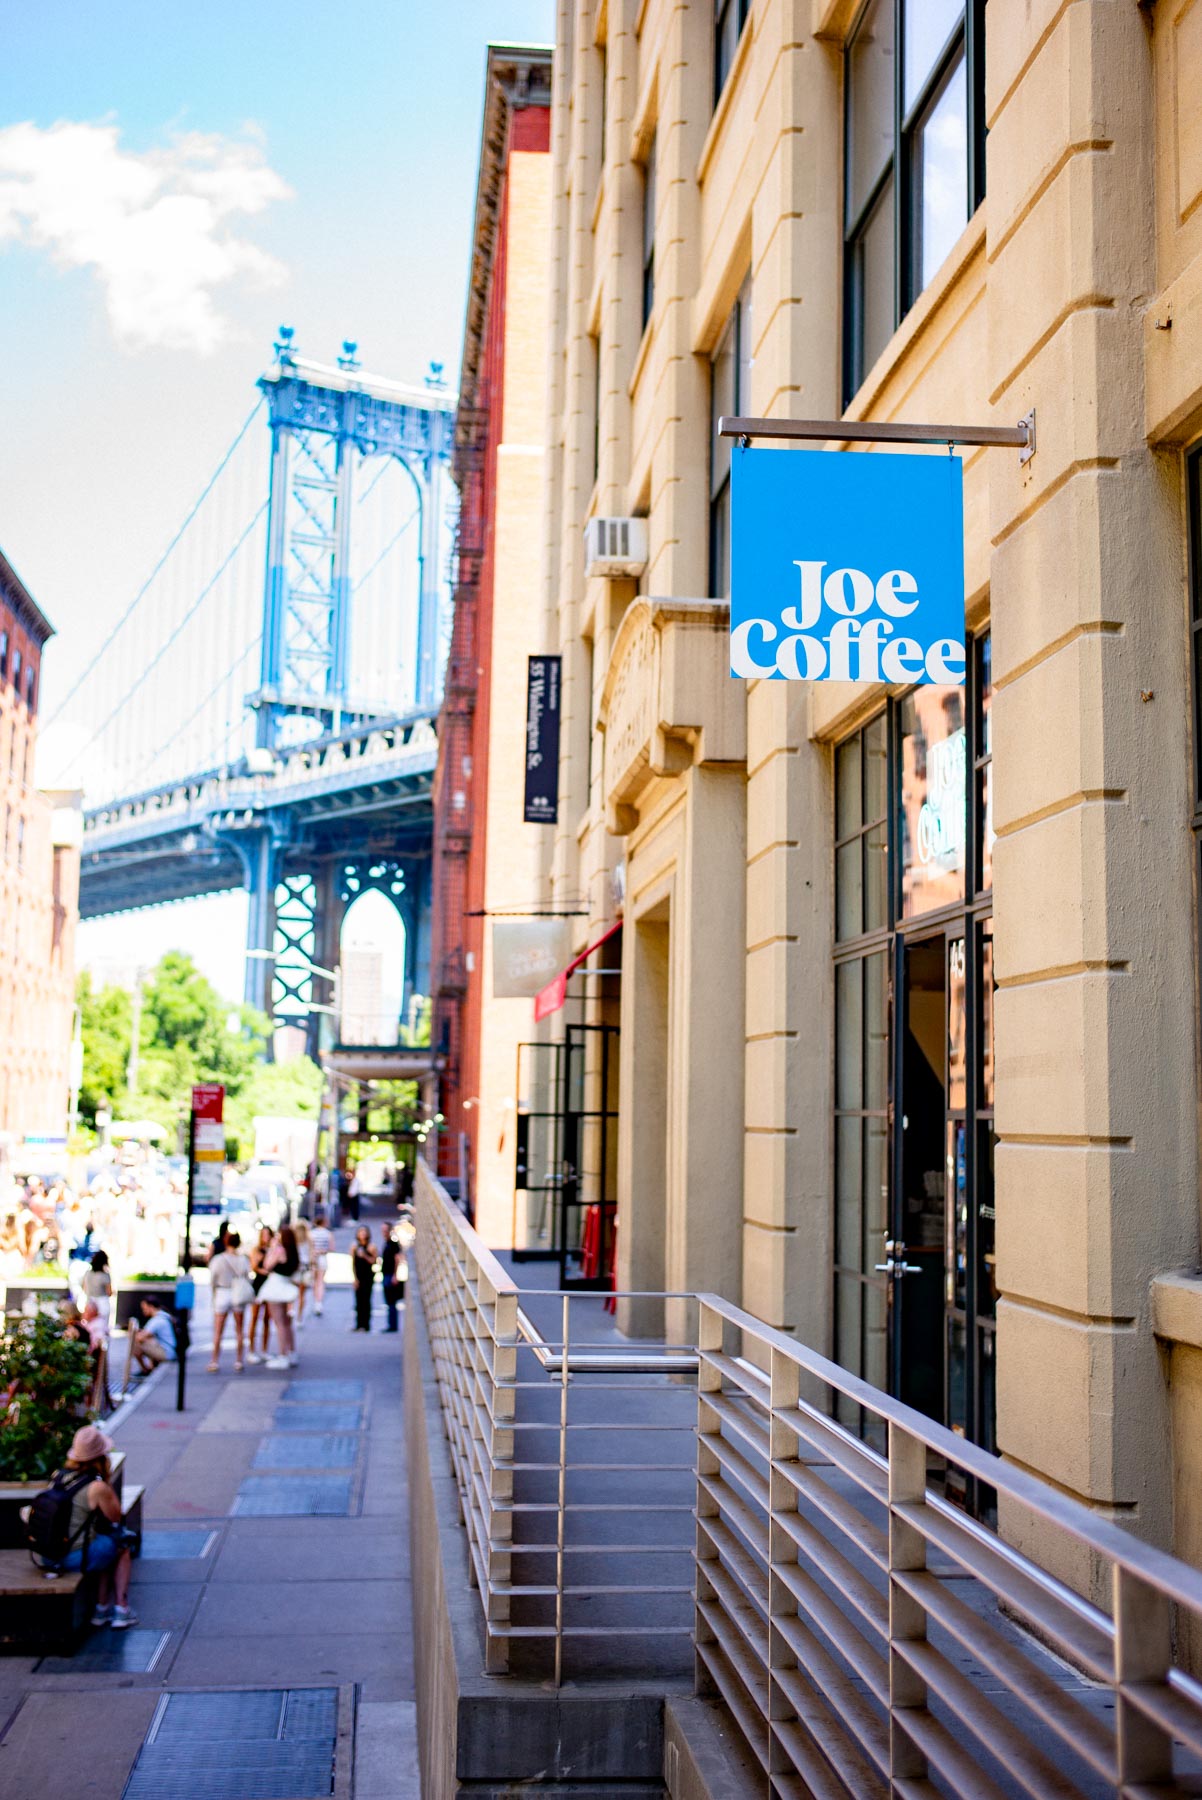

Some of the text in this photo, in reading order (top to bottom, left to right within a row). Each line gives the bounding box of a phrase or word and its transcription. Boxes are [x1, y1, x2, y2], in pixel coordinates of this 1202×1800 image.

[781, 560, 919, 630] Joe
[730, 618, 966, 684] Coffee
[527, 679, 545, 751] Washington
